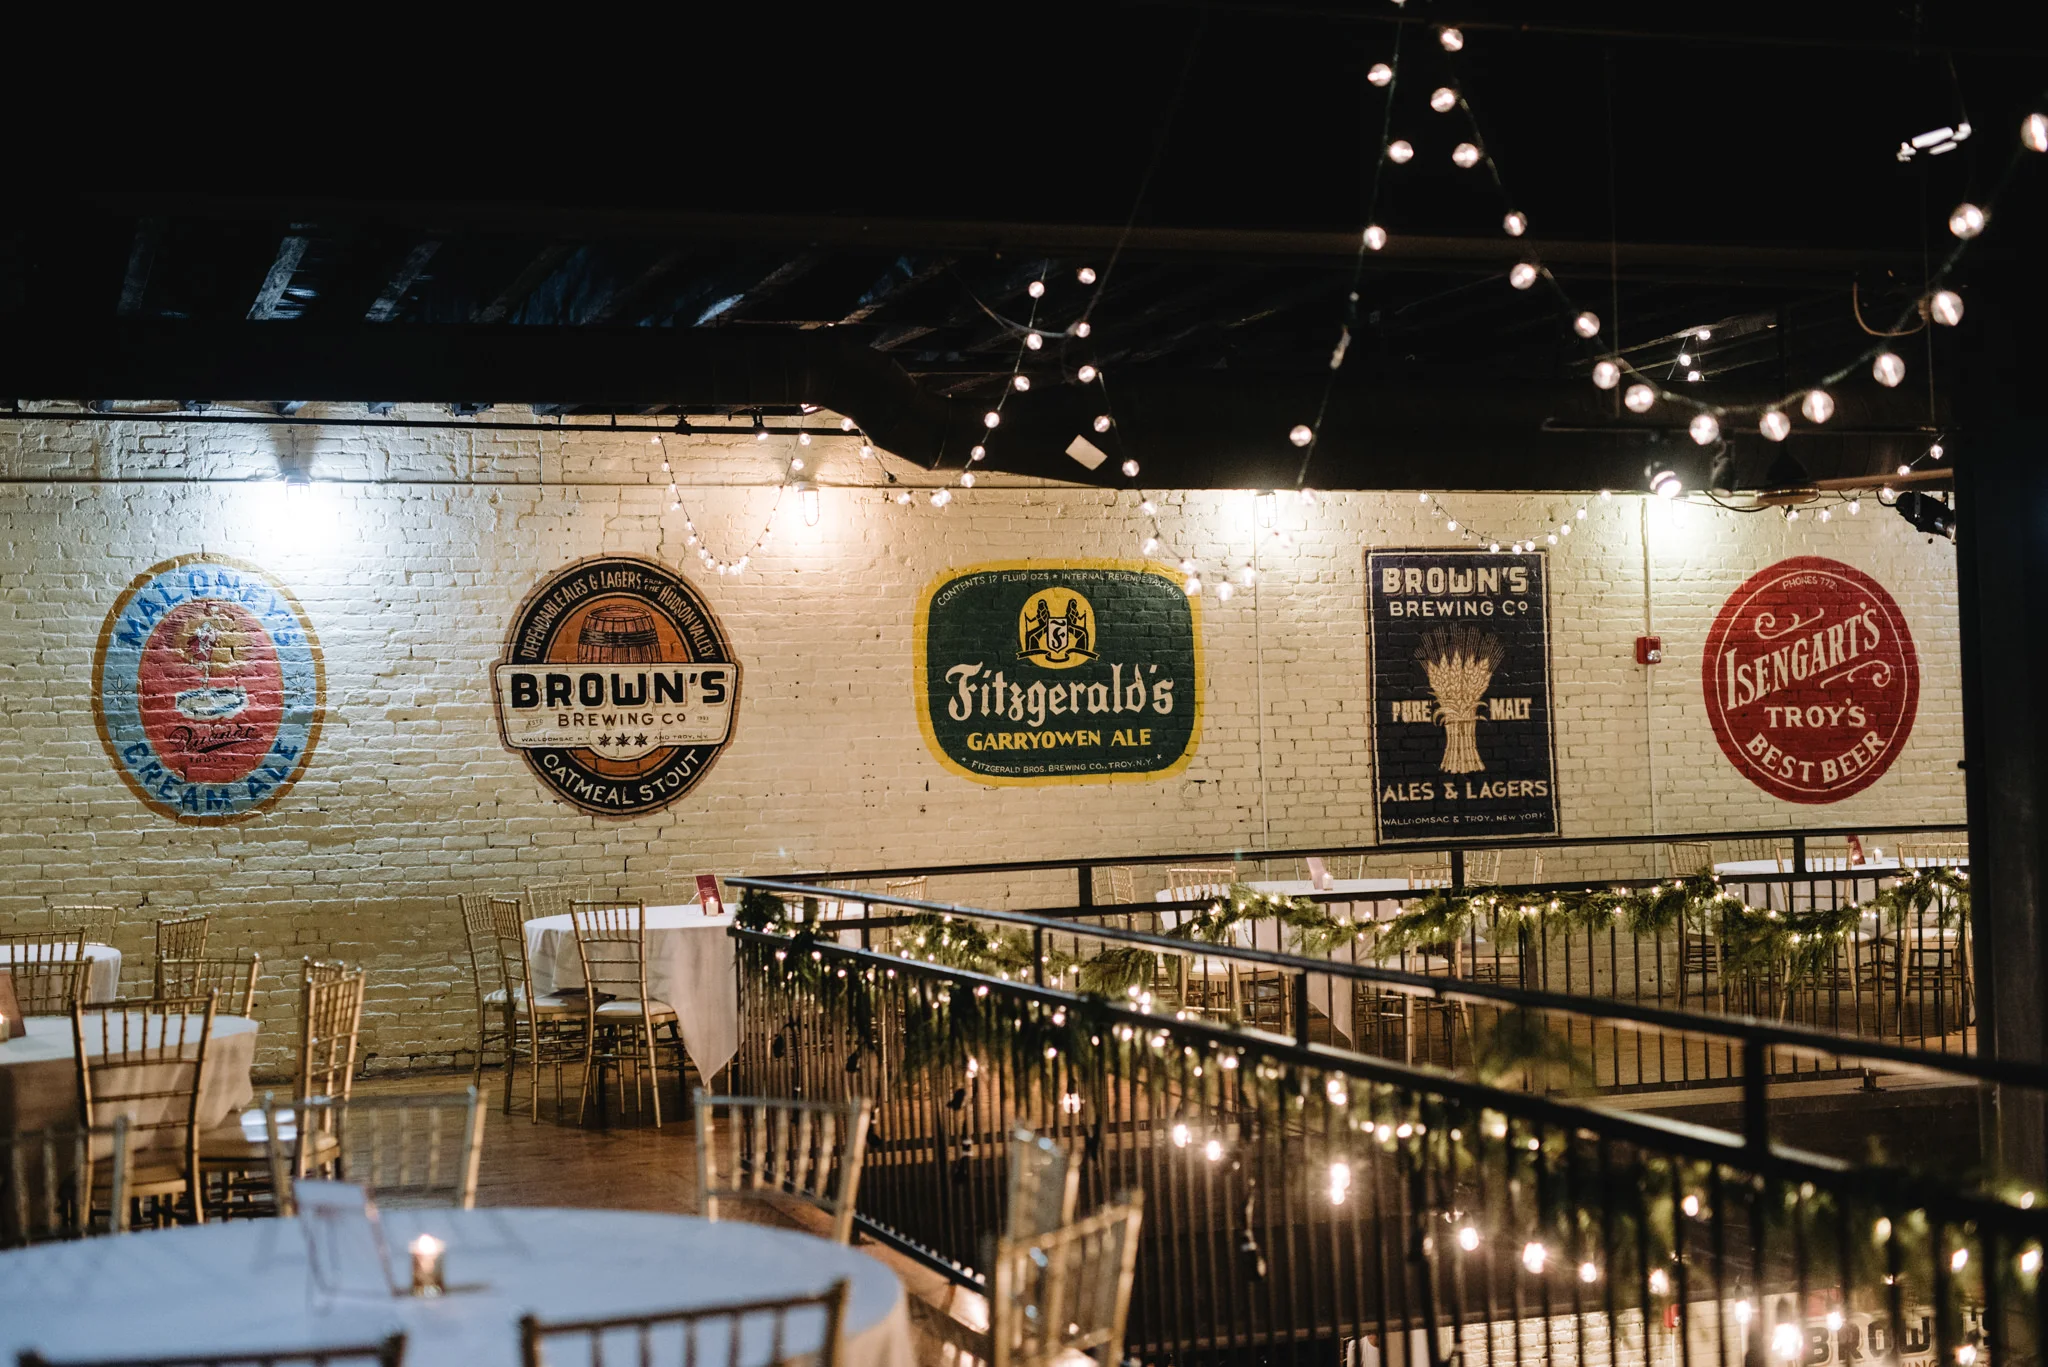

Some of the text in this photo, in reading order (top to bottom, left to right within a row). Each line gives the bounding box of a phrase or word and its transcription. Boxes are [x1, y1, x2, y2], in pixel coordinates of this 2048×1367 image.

[937, 576, 985, 606] CONTENTS
[1002, 574, 1027, 582] FLUID
[1108, 572, 1147, 583] REVENUE
[1163, 584, 1180, 600] PAID
[1382, 567, 1529, 595] BROWN'S
[1782, 575, 1818, 590] PHONES
[520, 591, 566, 659] DEPENDABLE
[561, 578, 588, 603] ALES
[600, 570, 642, 590] LAGERS
[658, 585, 716, 657] HUDSON VALLEY
[1390, 600, 1494, 617] BREWING
[511, 671, 726, 709] BROWN'S
[945, 661, 1174, 727] Fitzgerald's
[558, 712, 654, 727] BREWING
[1392, 698, 1532, 723] PURE MALT
[1764, 698, 1866, 728] TROY'S
[967, 728, 1151, 751] GARRYOWEN ALE
[971, 760, 1021, 774] FITZGERALD
[1023, 765, 1047, 773] BROS.
[1049, 763, 1086, 772] BREWING
[1745, 730, 1886, 784] BEST BEER
[123, 738, 298, 811] CREAM ALE
[543, 748, 699, 806] OATMEAL STOUT
[1382, 780, 1549, 802] ALES & LAGERS
[1453, 815, 1459, 823] &
[1496, 814, 1516, 822] NEW
